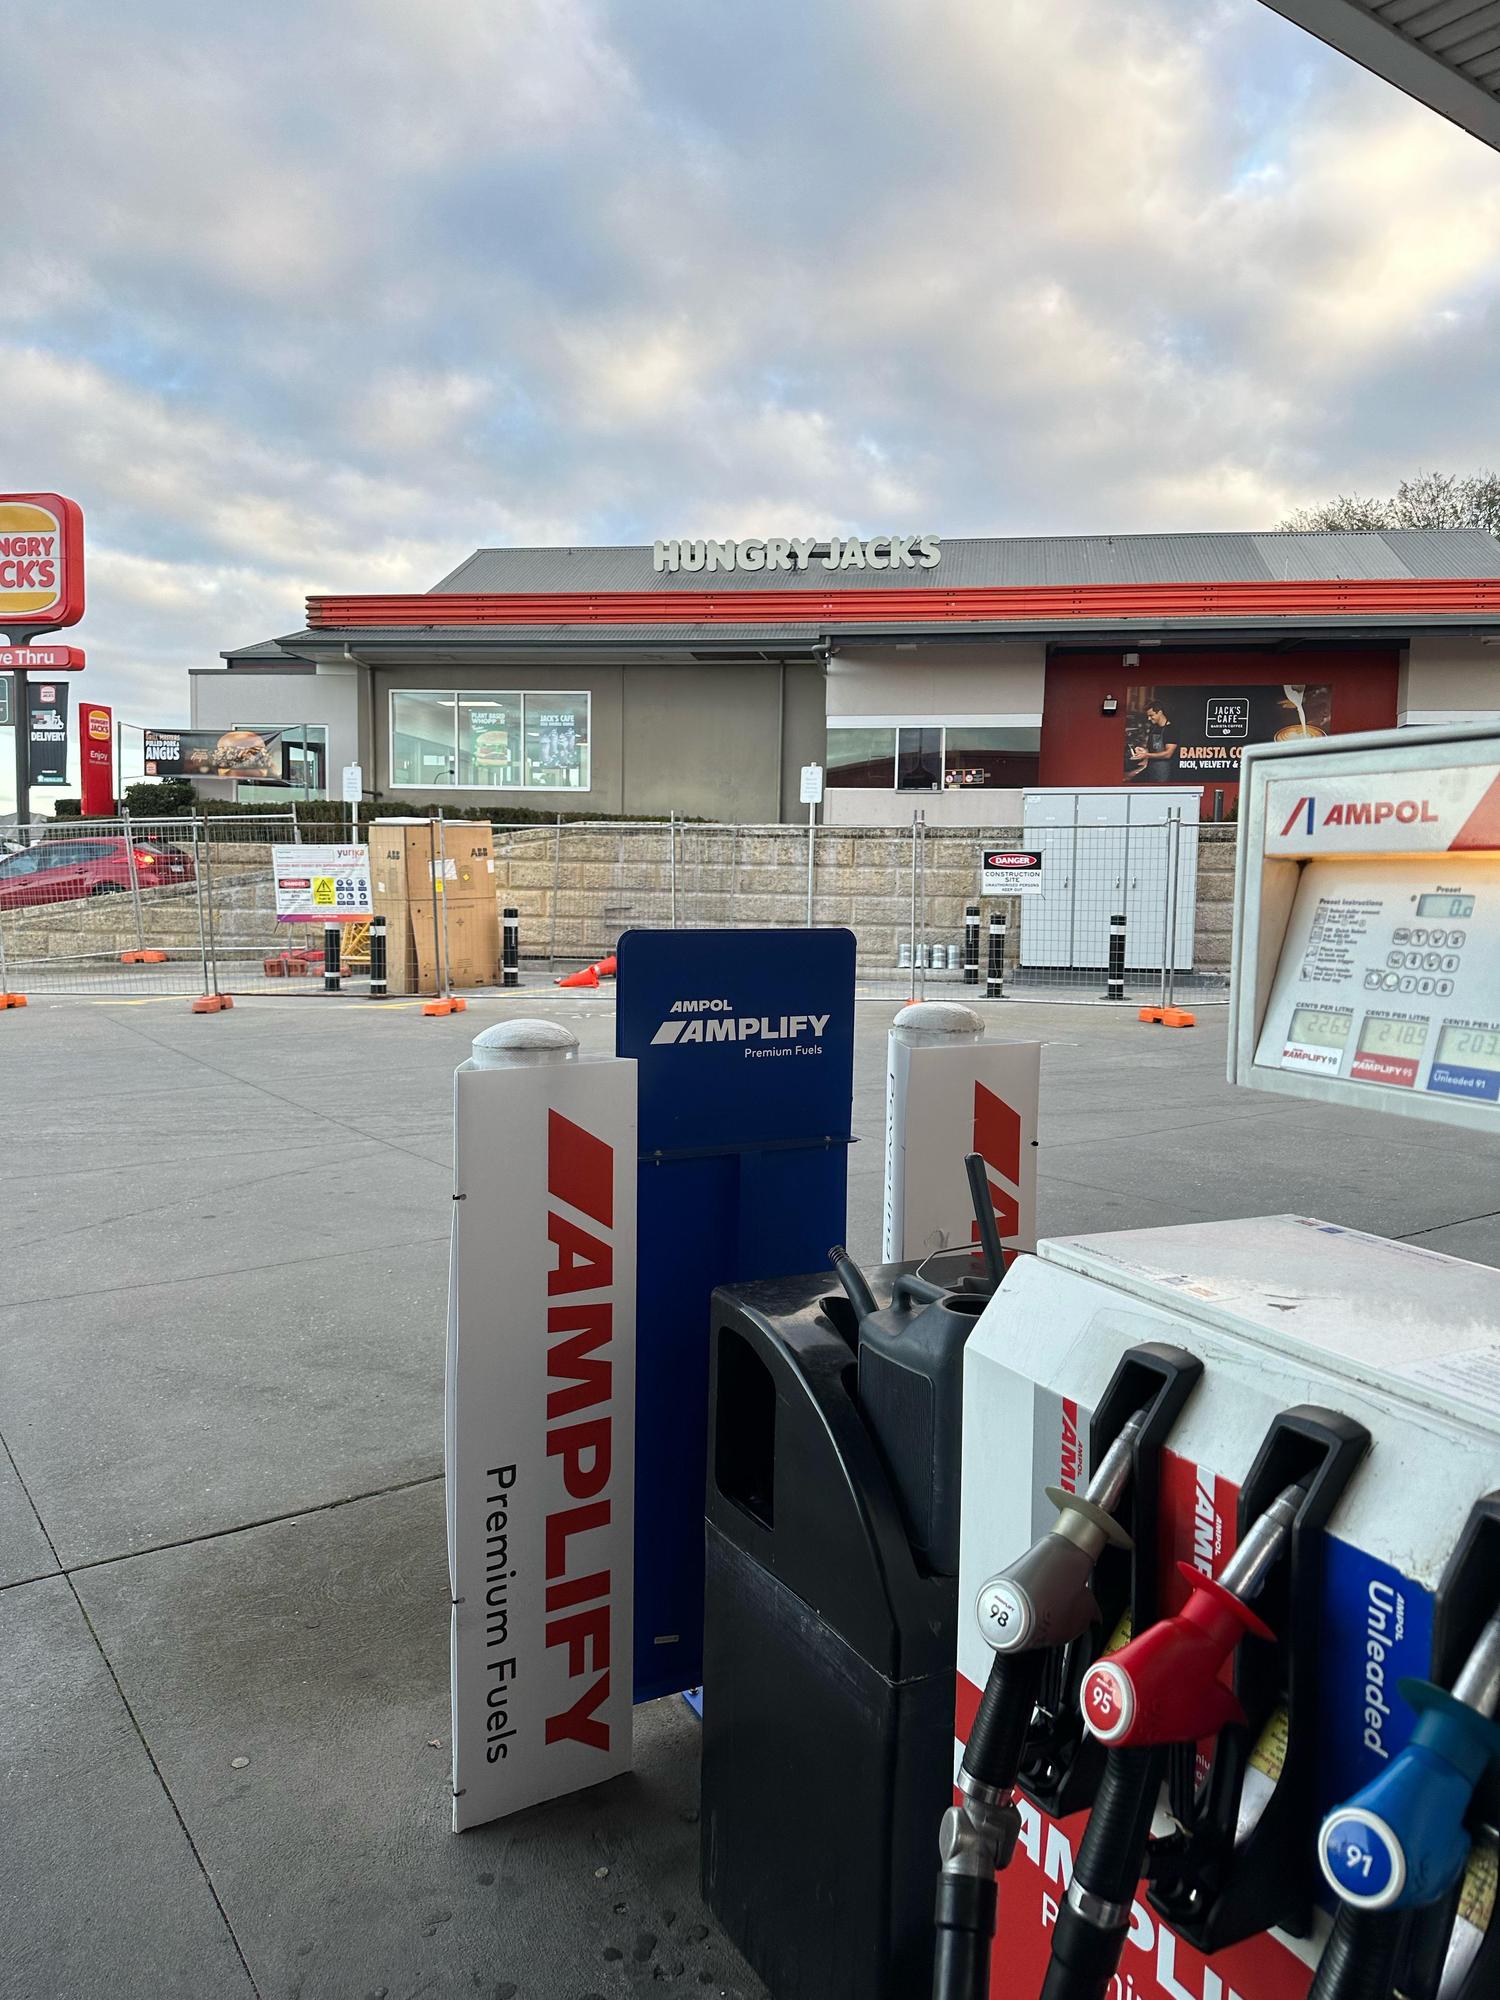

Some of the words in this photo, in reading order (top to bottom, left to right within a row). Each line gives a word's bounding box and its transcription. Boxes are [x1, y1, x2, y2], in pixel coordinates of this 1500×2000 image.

[653, 537, 816, 572] HUNGRY
[822, 535, 941, 569] JACK'S
[15, 650, 54, 664] Thru
[1214, 706, 1241, 715] JACK'S
[1217, 715, 1238, 723] CAFE
[31, 732, 65, 741] DELIVERY
[90, 751, 108, 760] Enjoy
[146, 747, 180, 760] ANGUS
[1180, 747, 1227, 759] BARISTA
[1179, 761, 1198, 770] RICH,
[1323, 800, 1439, 826] AMPOL
[670, 999, 733, 1013] AMPOL
[1366, 1009, 1390, 1017] CENTS
[1392, 1011, 1407, 1019] PER
[1409, 1014, 1430, 1022] LITRE
[1443, 1018, 1470, 1026] CENTS
[679, 1014, 830, 1044] AMPLIFY
[745, 1046, 792, 1058] Premium
[795, 1044, 823, 1056] Fuels
[1288, 1050, 1327, 1063] AMPLIFY
[1357, 1061, 1402, 1075] AMPLIFY
[1433, 1072, 1474, 1087] Unleaded
[546, 1210, 613, 1752] AMPLIFY
[486, 1464, 516, 1647] Premium
[990, 1604, 1009, 1627] 98
[1395, 1592, 1405, 1641] AMPOL
[1364, 1580, 1394, 1758] Unleaded
[1093, 1686, 1112, 1714] 95
[486, 1657, 517, 1764] Fuels
[1346, 1845, 1373, 1877] 91
